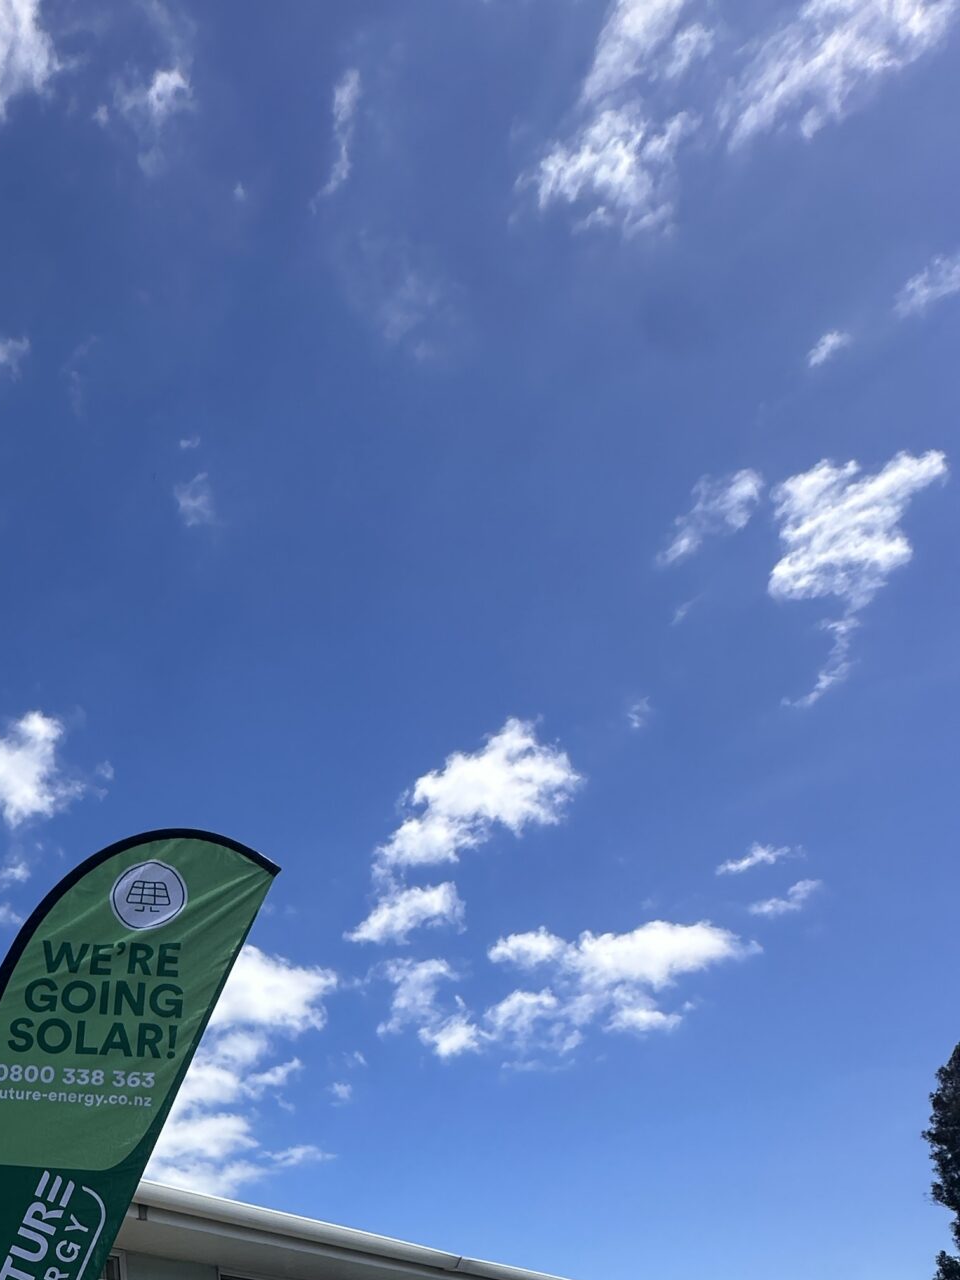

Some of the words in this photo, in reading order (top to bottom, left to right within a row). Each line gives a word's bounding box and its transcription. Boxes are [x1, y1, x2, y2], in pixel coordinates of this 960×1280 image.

[42, 939, 182, 978] WE'RE
[23, 977, 184, 1019] GOING
[7, 1017, 178, 1060] SOLAR!
[61, 1067, 105, 1086] 338
[111, 1070, 156, 1089] 363
